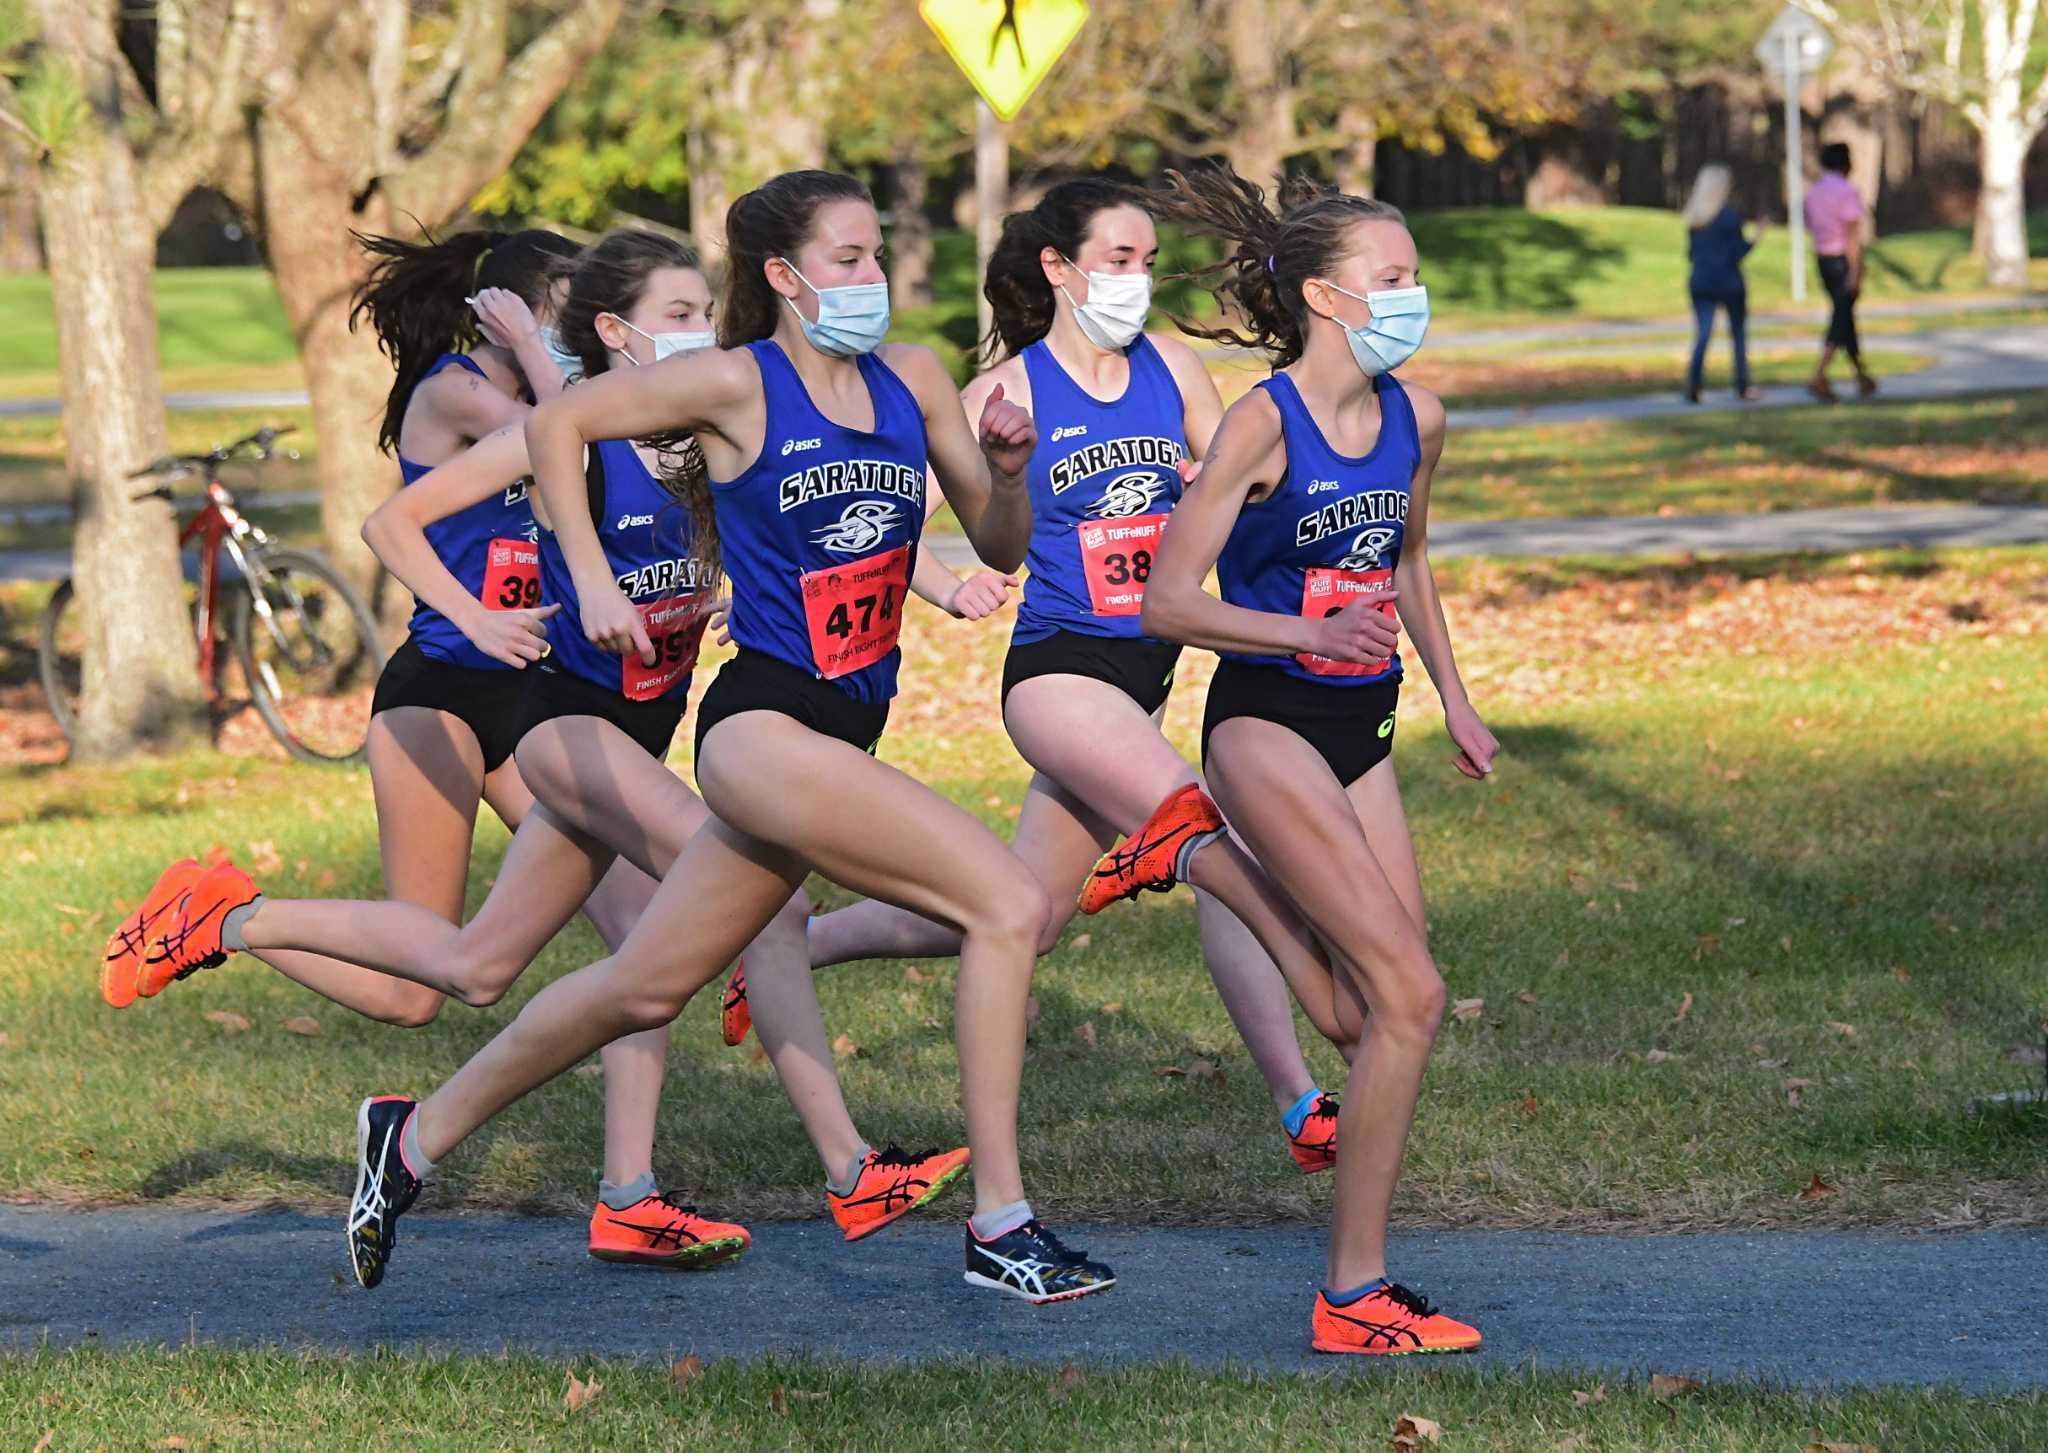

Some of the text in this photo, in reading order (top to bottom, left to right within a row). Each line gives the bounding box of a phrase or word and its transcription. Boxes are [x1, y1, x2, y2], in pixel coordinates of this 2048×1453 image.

[779, 459, 924, 513] SARATOGA
[1050, 436, 1183, 496] SARATOGA
[825, 584, 894, 640] 474
[635, 675, 662, 691] FINISH
